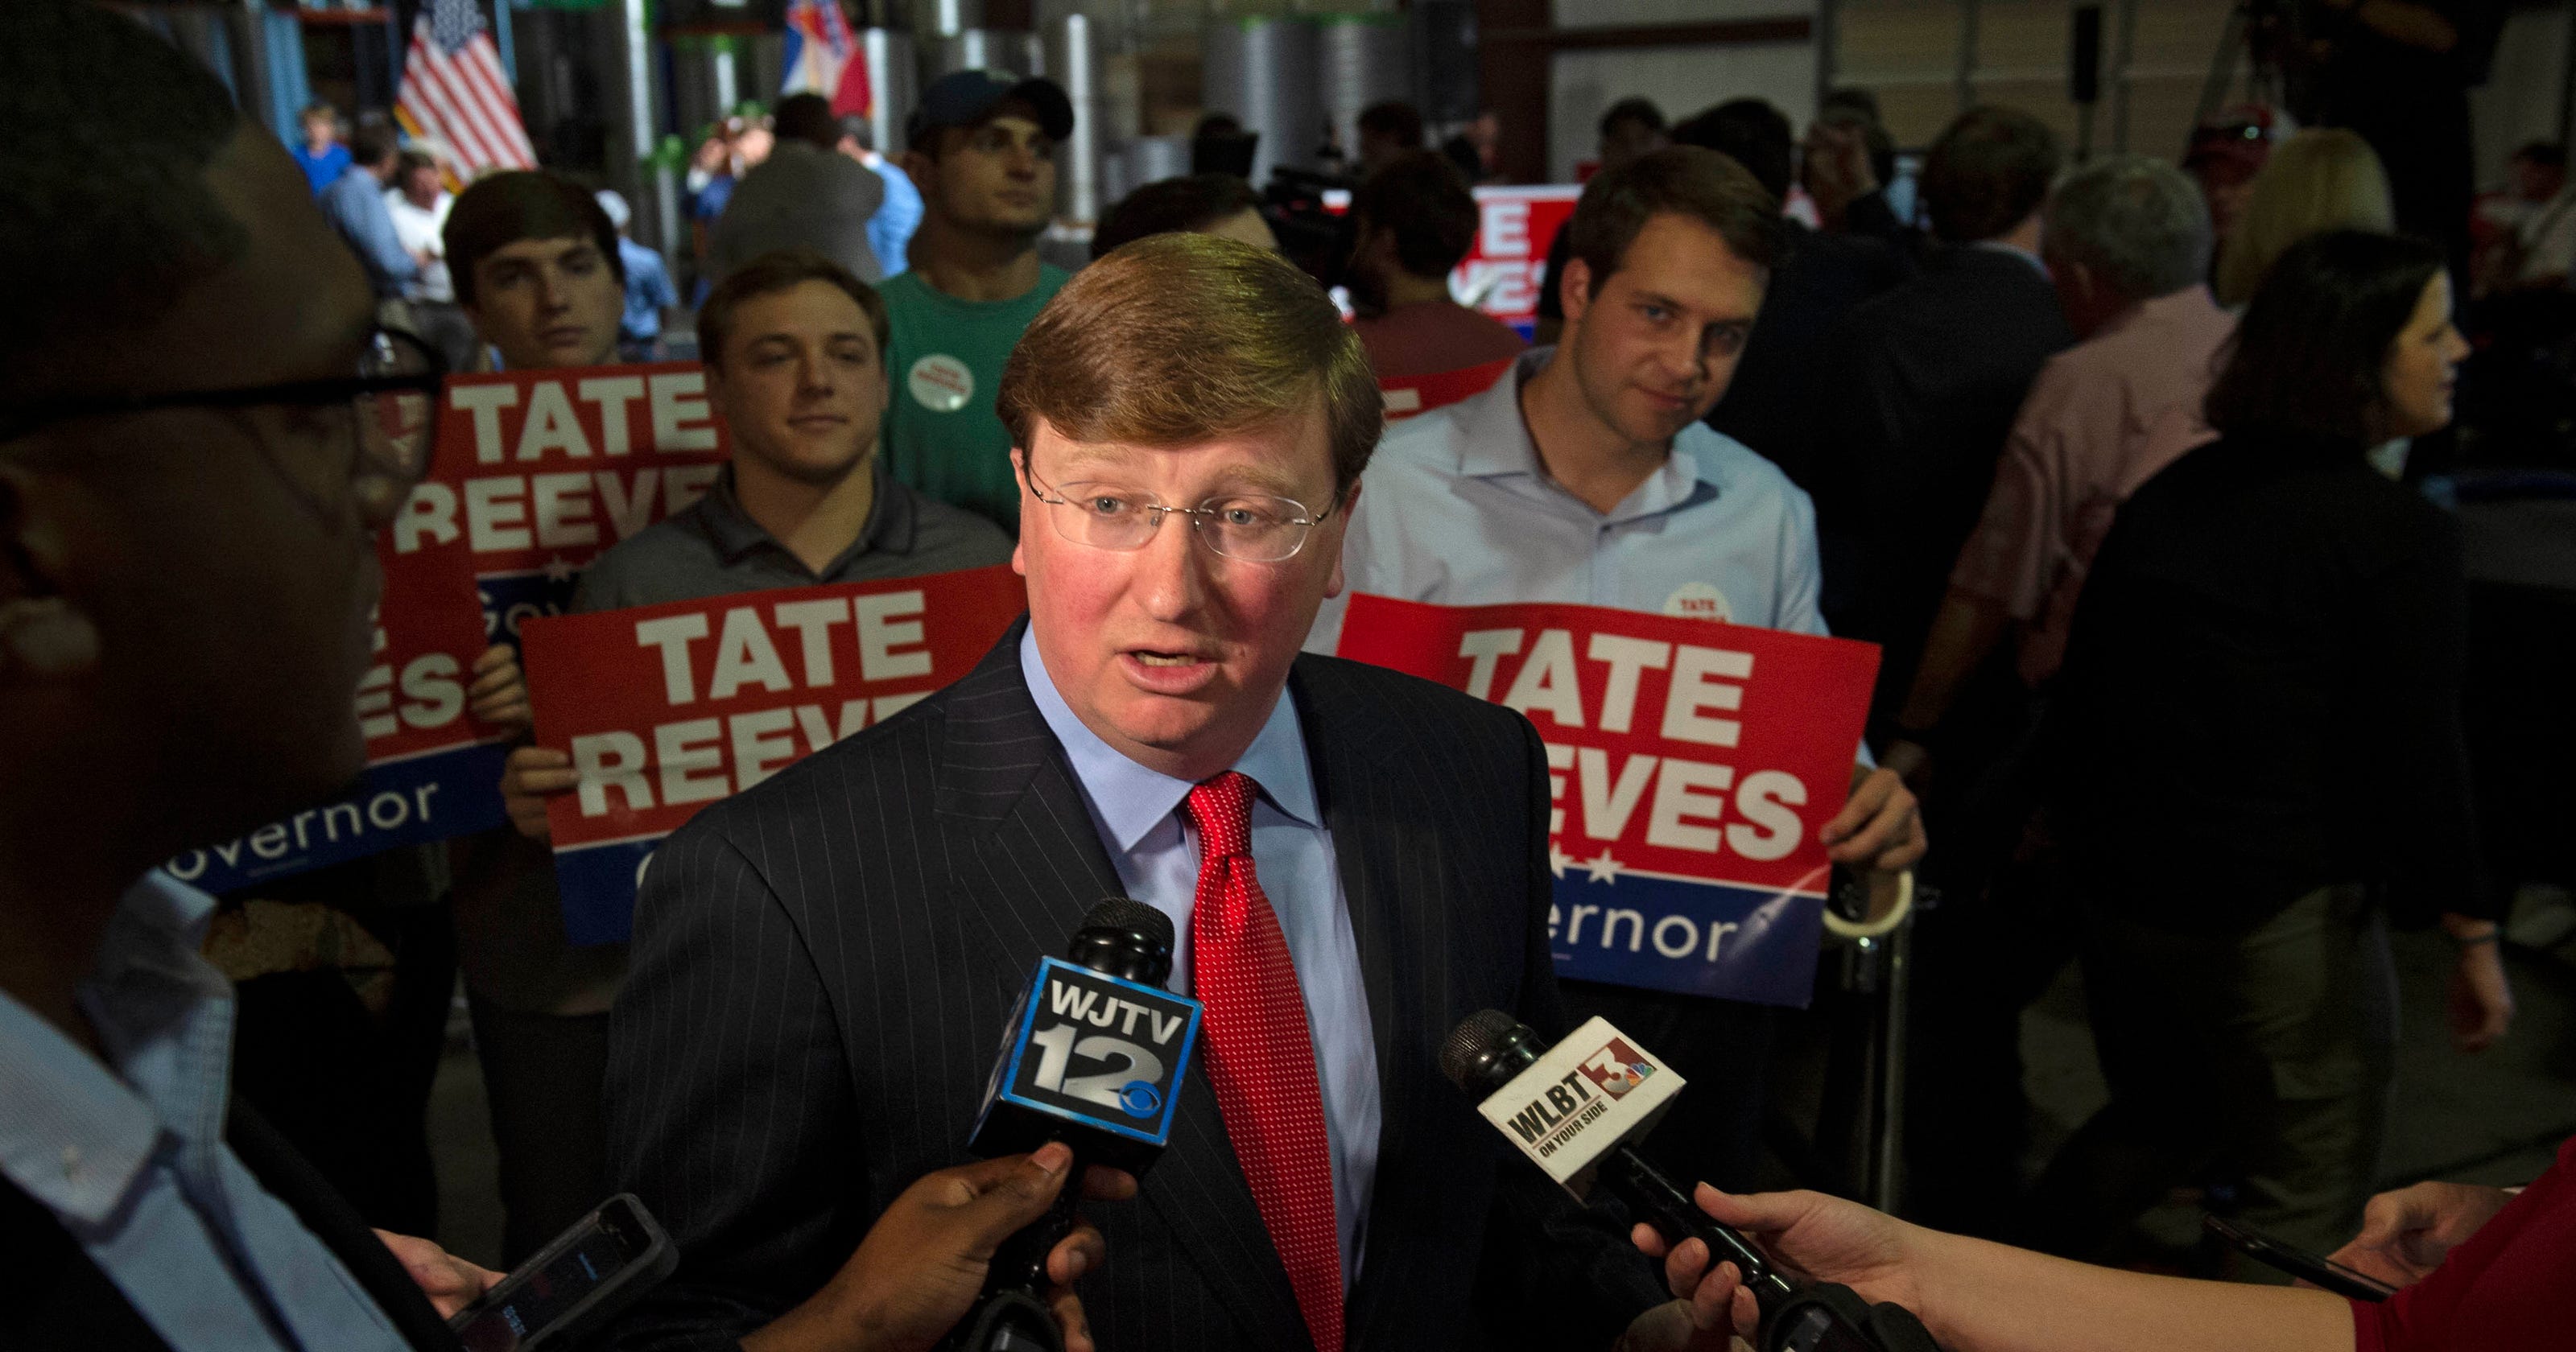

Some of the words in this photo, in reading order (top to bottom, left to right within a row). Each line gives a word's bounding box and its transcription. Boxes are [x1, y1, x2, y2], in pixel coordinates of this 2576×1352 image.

[450, 372, 718, 464] TATE
[394, 464, 722, 554] REEVE
[635, 590, 933, 705] TATE
[1458, 628, 1756, 748] TATE
[571, 690, 936, 817] REEV
[167, 781, 440, 880] overnor
[1051, 979, 1183, 1045] WJTV
[1032, 1022, 1164, 1111] 12
[1507, 1070, 1591, 1144] WLBT
[1584, 1046, 1634, 1094] 3
[1538, 1140, 1558, 1158] ON
[1552, 1119, 1584, 1146] YOUR
[1580, 1100, 1608, 1125] SIDE
